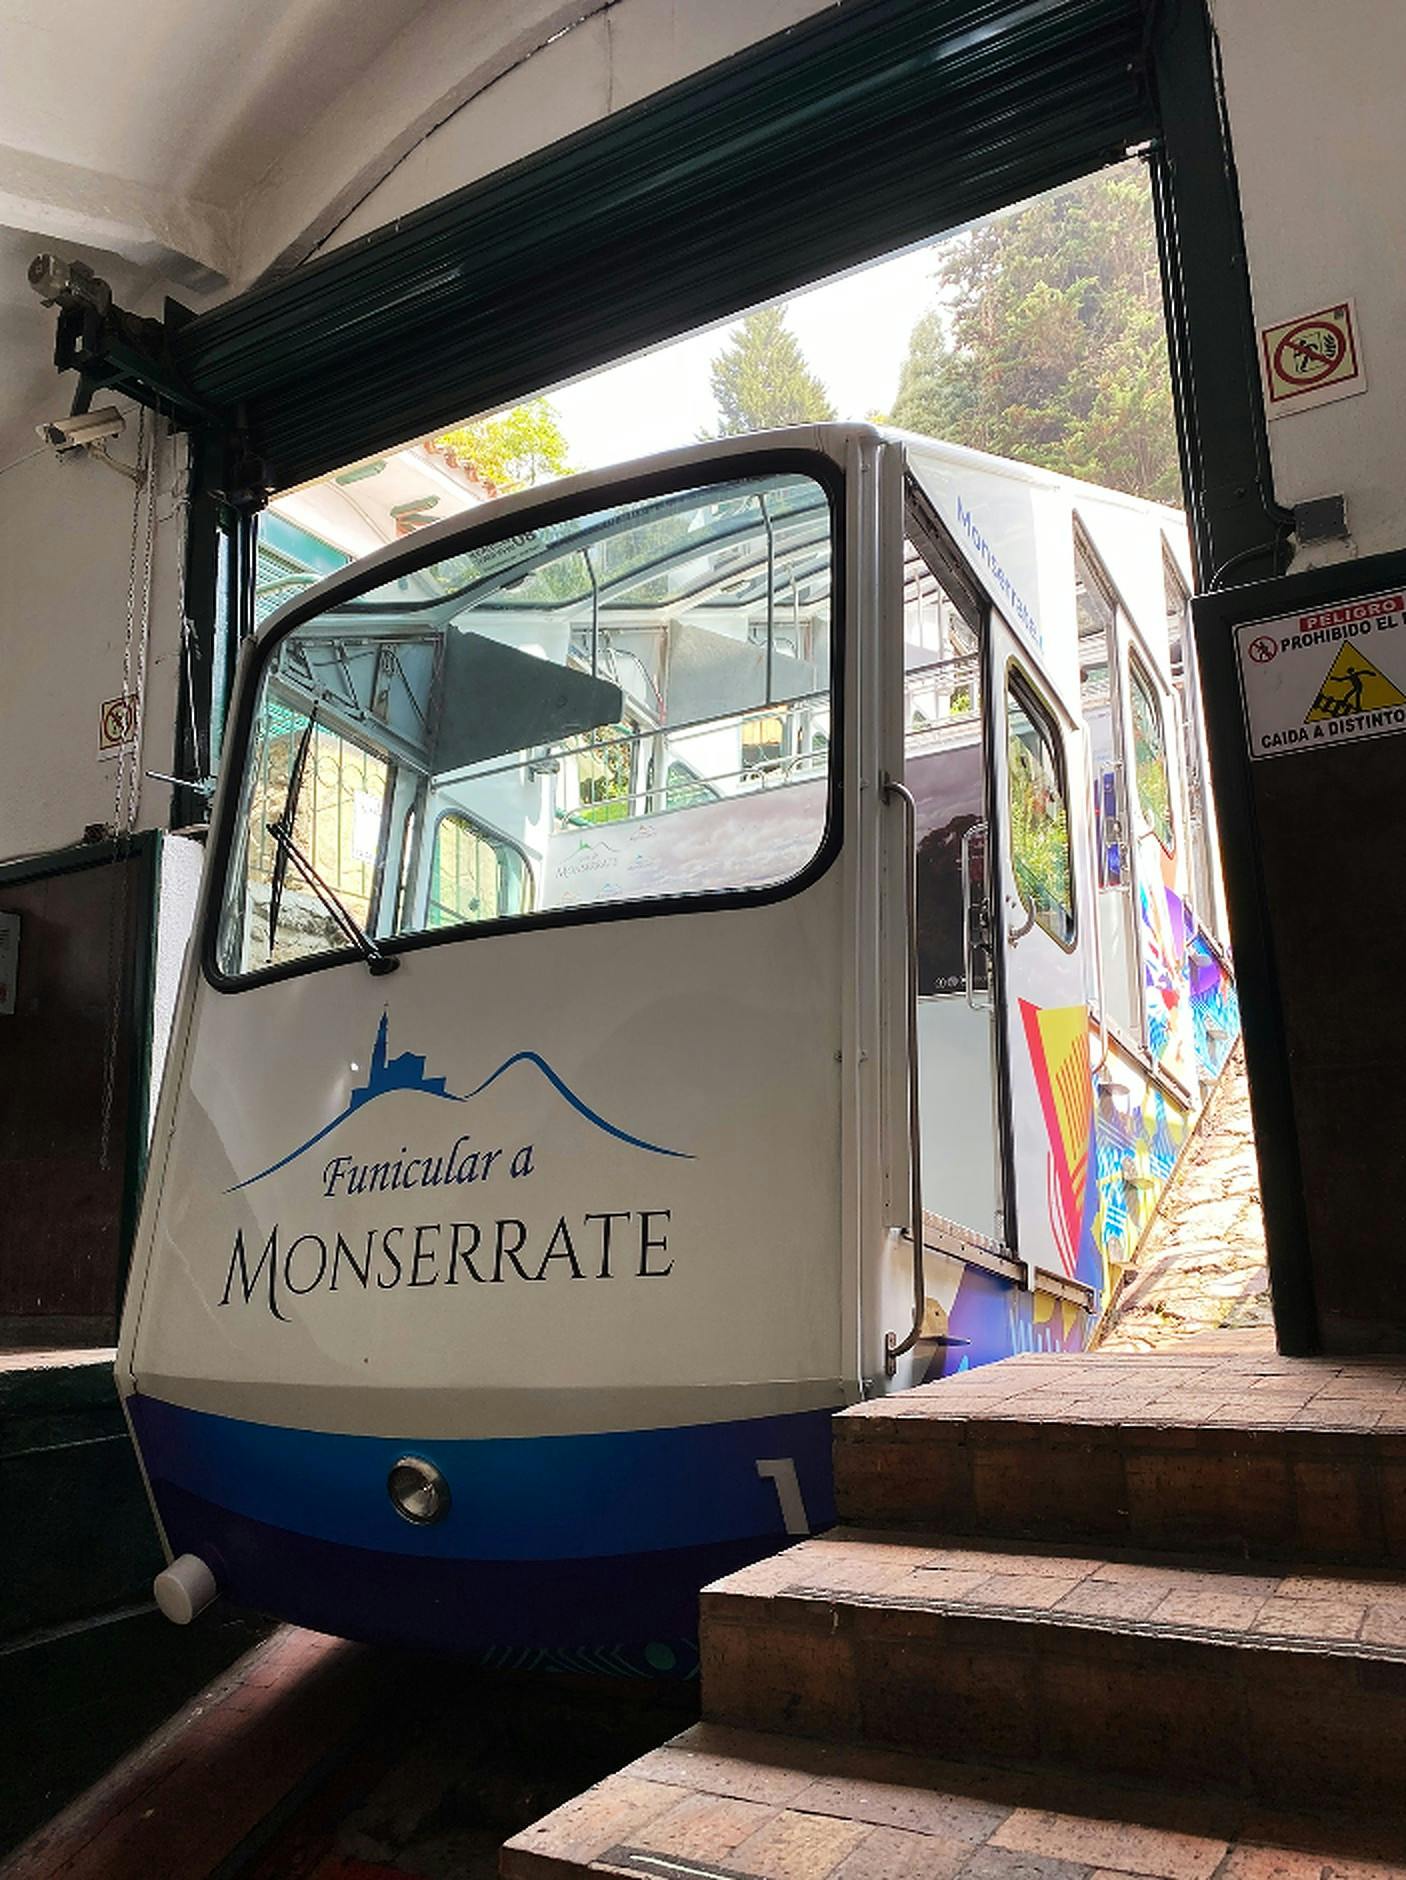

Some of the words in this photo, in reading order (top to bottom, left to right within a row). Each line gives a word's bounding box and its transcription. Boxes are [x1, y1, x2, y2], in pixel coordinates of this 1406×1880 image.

[1281, 620, 1371, 652] PROHIBIDO
[1375, 615, 1399, 631] EL
[1306, 600, 1397, 629] PELIGRO
[1261, 727, 1309, 749] CAIDA
[1313, 724, 1325, 738] A
[1329, 708, 1405, 735] DISTINTO
[323, 1136, 503, 1198] Funicular
[509, 1144, 536, 1178] a
[217, 1209, 675, 1323] MONSERRATE
[755, 1457, 811, 1535] 1
